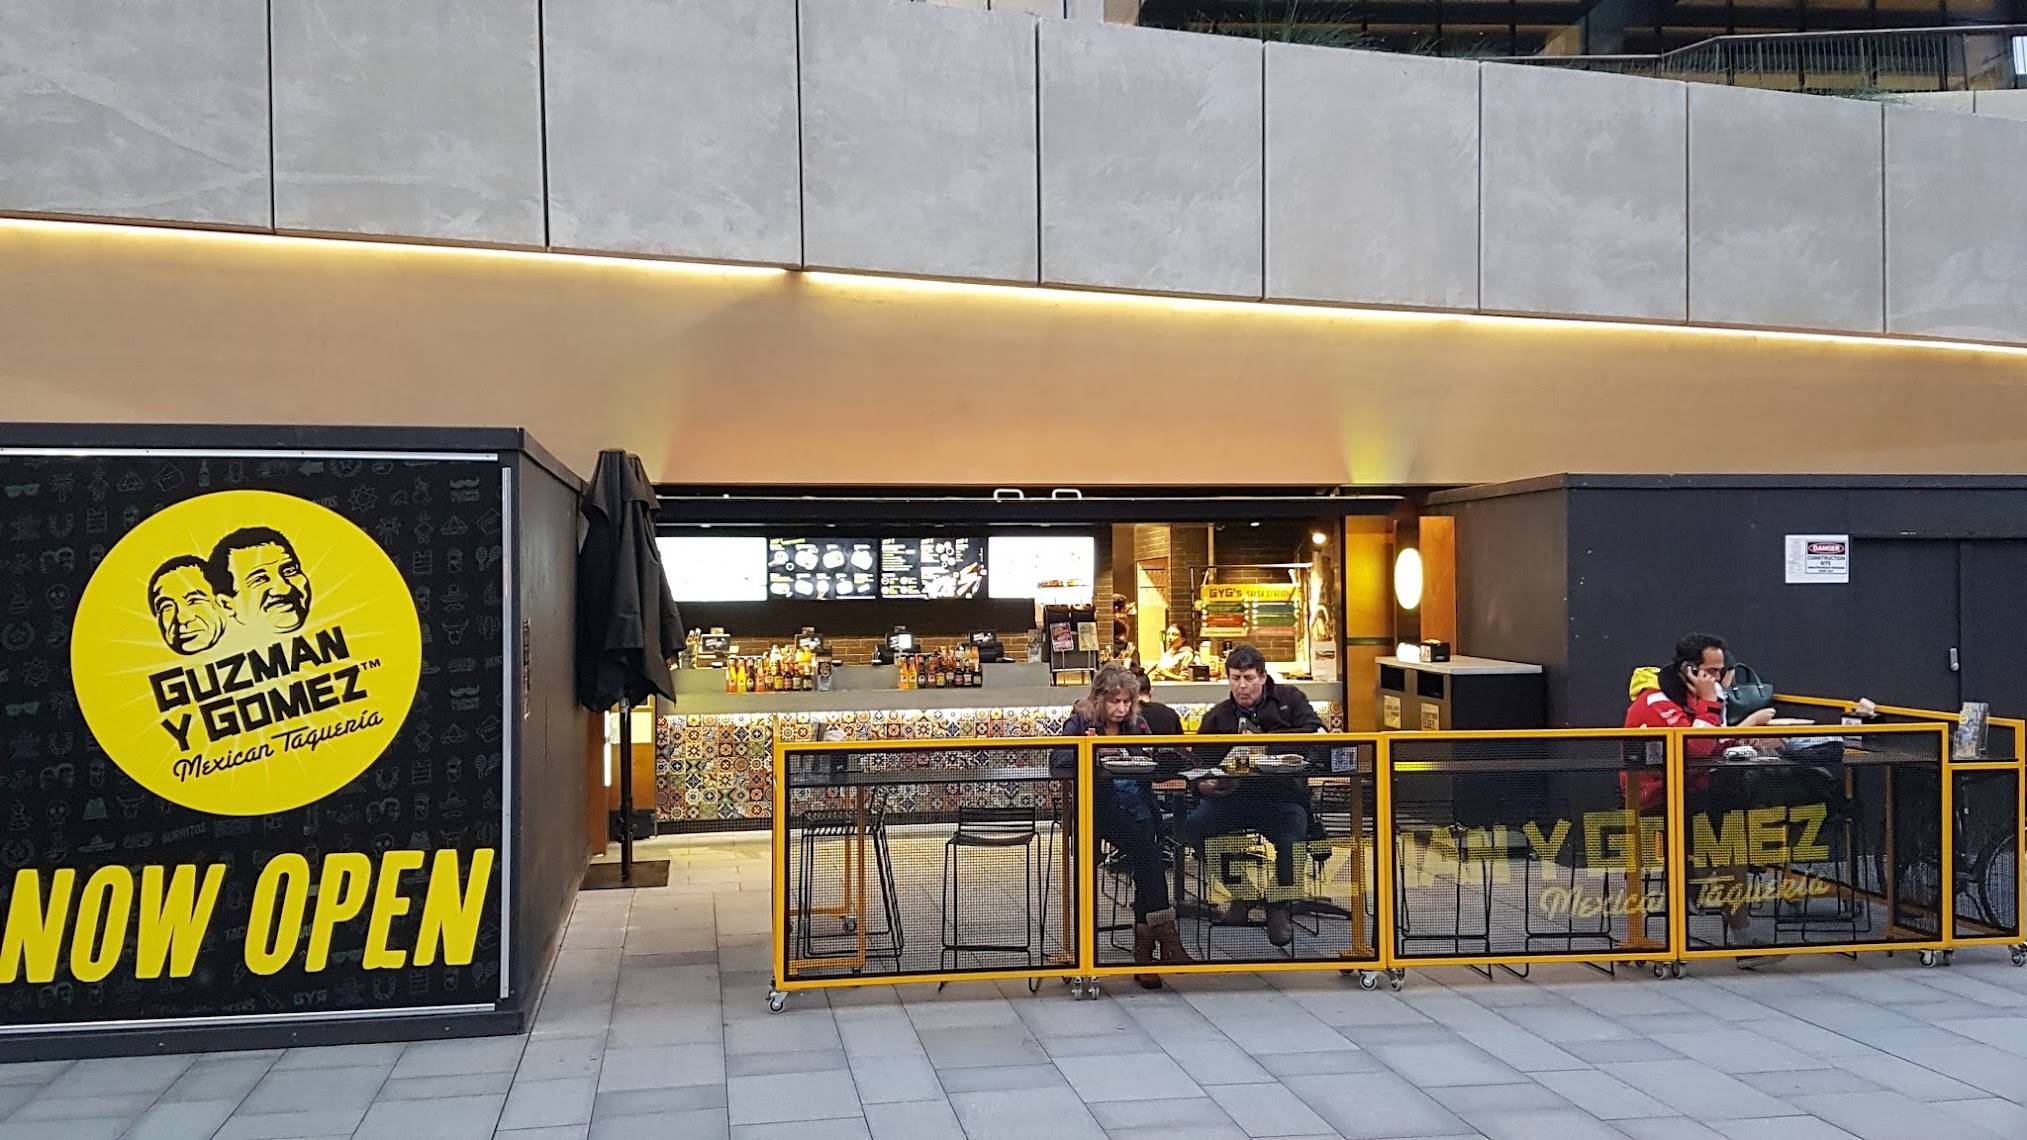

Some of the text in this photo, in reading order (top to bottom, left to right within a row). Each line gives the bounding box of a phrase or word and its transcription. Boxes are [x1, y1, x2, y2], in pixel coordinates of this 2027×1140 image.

[1812, 544, 1841, 552] DANGER
[1246, 589, 1265, 598] SALSA
[148, 626, 350, 713] GUZMAN
[161, 714, 192, 752] Y
[199, 665, 368, 743] GOMEZ
[173, 743, 275, 784] Mexican
[1522, 817, 1572, 881] Y
[1582, 802, 1831, 874] GOMEZ
[0, 848, 495, 984] NOW OPEN
[1539, 883, 1666, 922] Mexica
